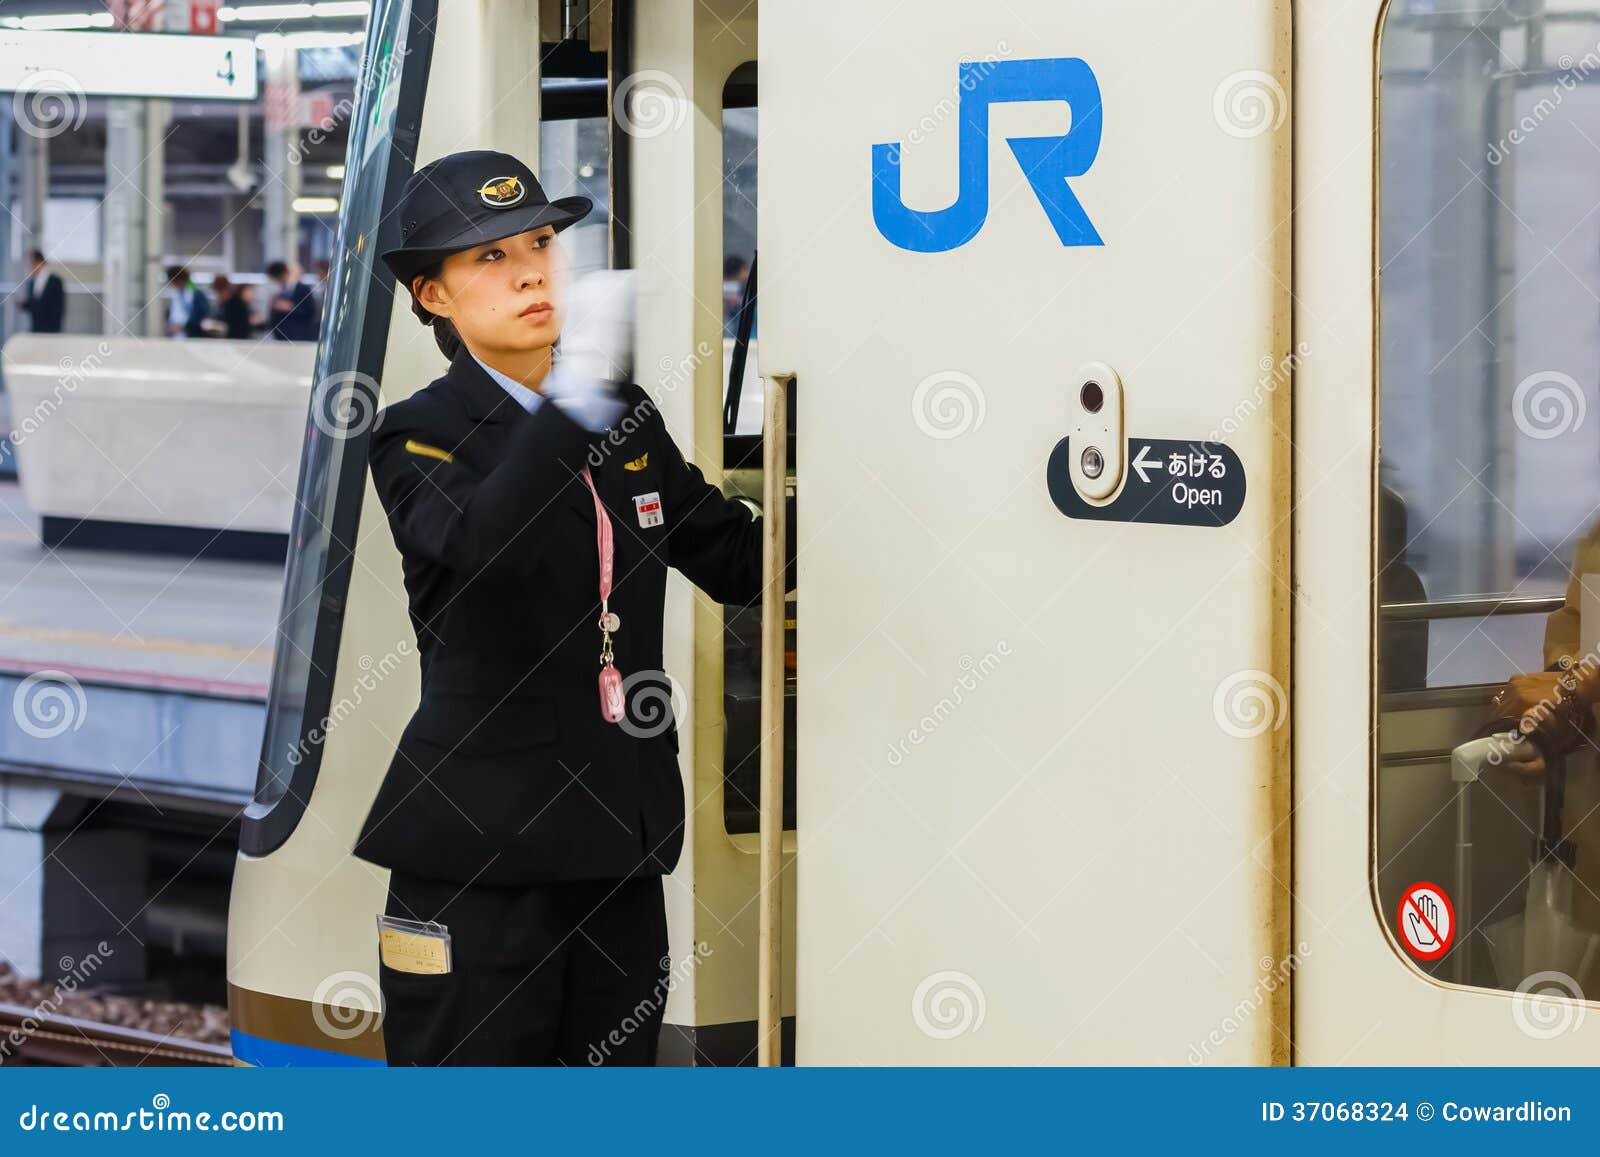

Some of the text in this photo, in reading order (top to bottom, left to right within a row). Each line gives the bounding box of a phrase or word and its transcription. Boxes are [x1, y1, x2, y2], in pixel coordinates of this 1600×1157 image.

[871, 57, 1105, 253] JR
[1168, 452, 1226, 479] あける
[1172, 482, 1222, 509] Open
